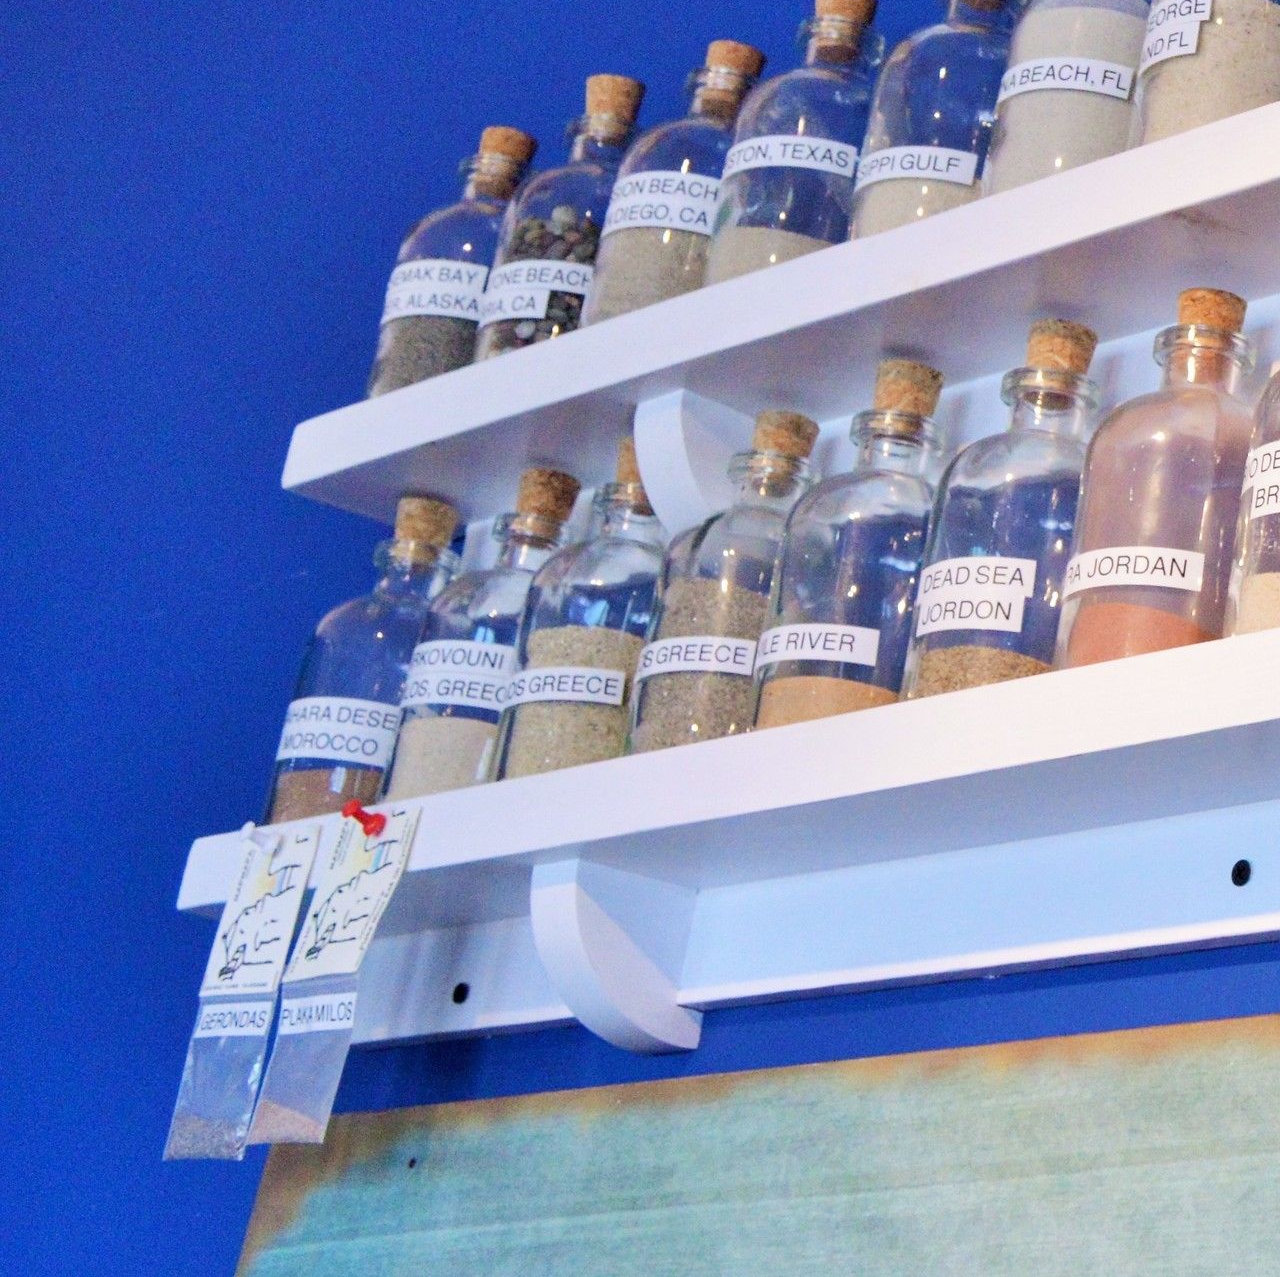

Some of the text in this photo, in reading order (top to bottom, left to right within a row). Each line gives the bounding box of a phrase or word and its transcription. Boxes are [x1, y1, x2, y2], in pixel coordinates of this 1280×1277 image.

[1167, 32, 1189, 51] FL
[1102, 69, 1127, 91] FL
[781, 143, 849, 169] TEXAS
[900, 154, 961, 173] GULF
[649, 178, 719, 201] BEACH
[679, 206, 709, 226] CA
[438, 267, 478, 286] BAY
[407, 293, 479, 313] ALASKA
[511, 295, 537, 312] CA
[1087, 555, 1188, 578] JORDAN
[923, 565, 1025, 595] DEAD SEA
[921, 599, 1013, 626] JORDON
[785, 631, 856, 653] RIVER
[656, 644, 749, 665] GREECE
[529, 675, 620, 696] GREECE
